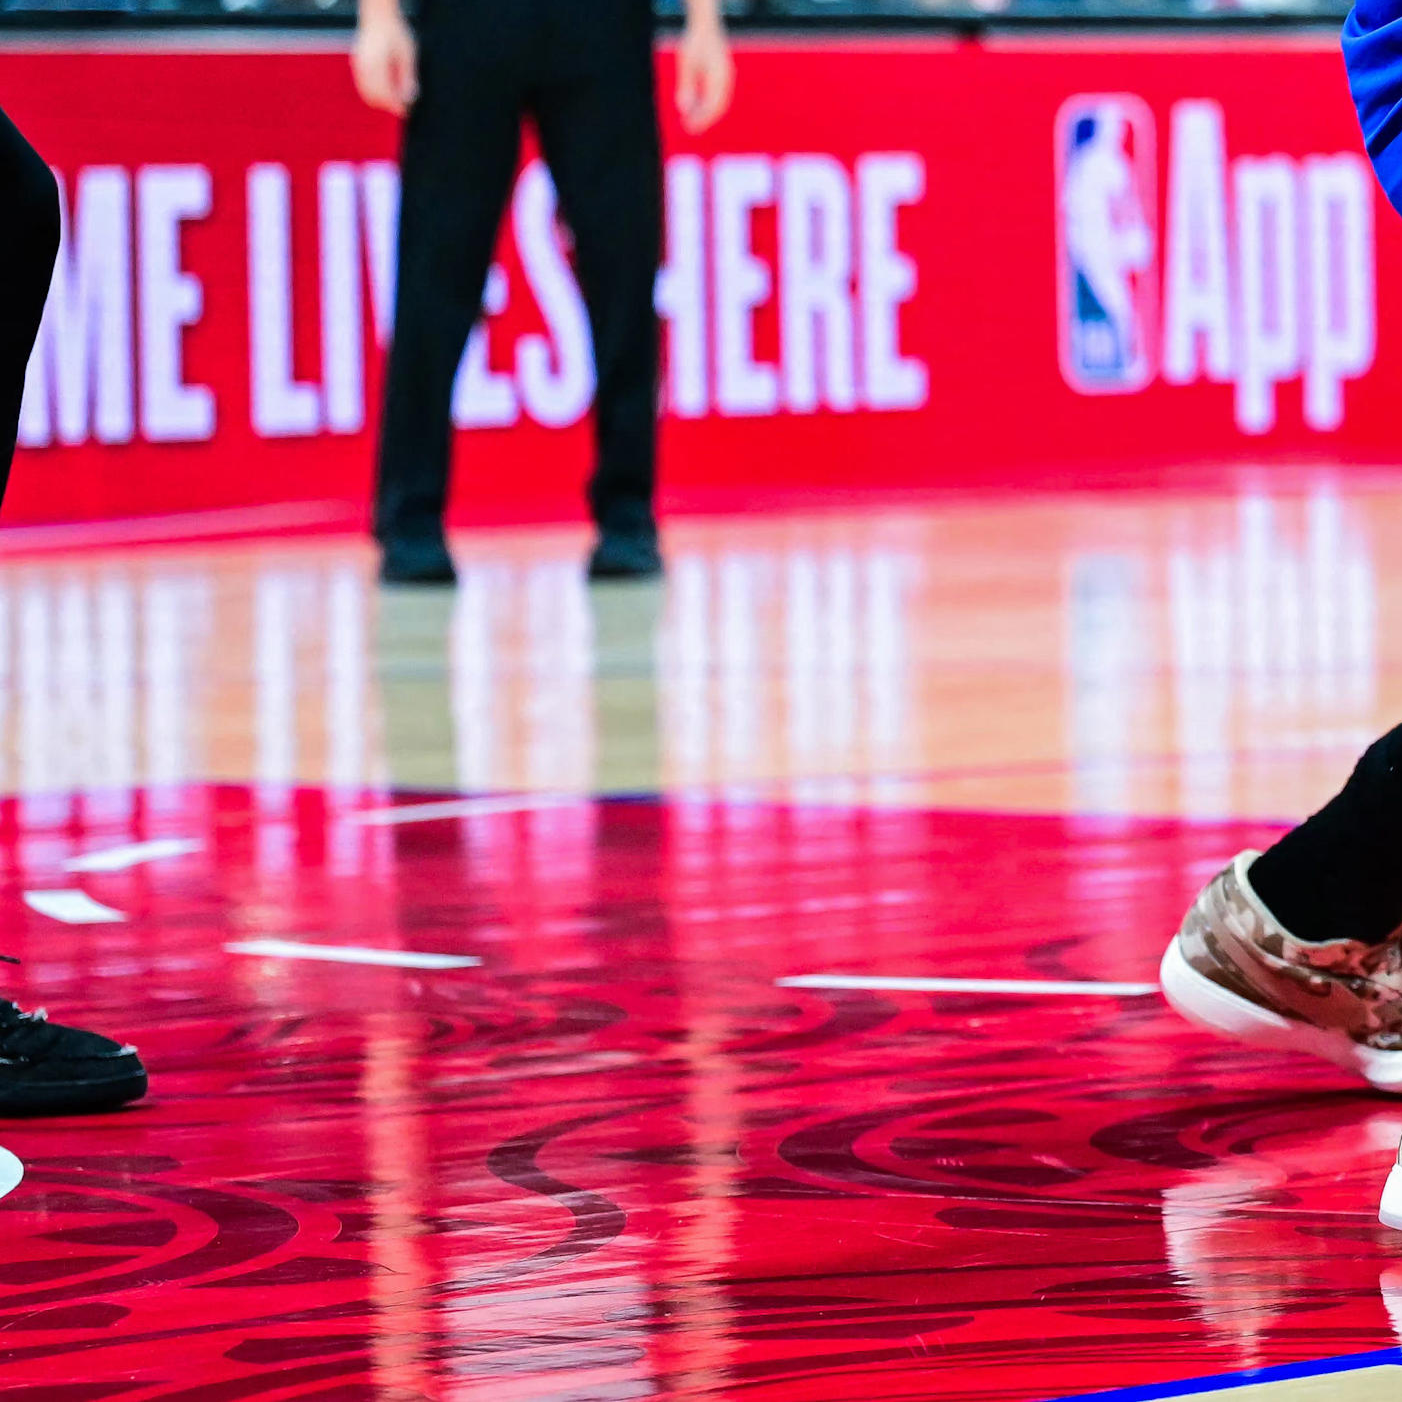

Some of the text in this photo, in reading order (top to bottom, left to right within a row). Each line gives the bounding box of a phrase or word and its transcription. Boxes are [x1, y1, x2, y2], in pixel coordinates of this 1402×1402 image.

[17, 161, 217, 448] ME
[655, 150, 931, 420] HERE
[1161, 96, 1378, 436] App
